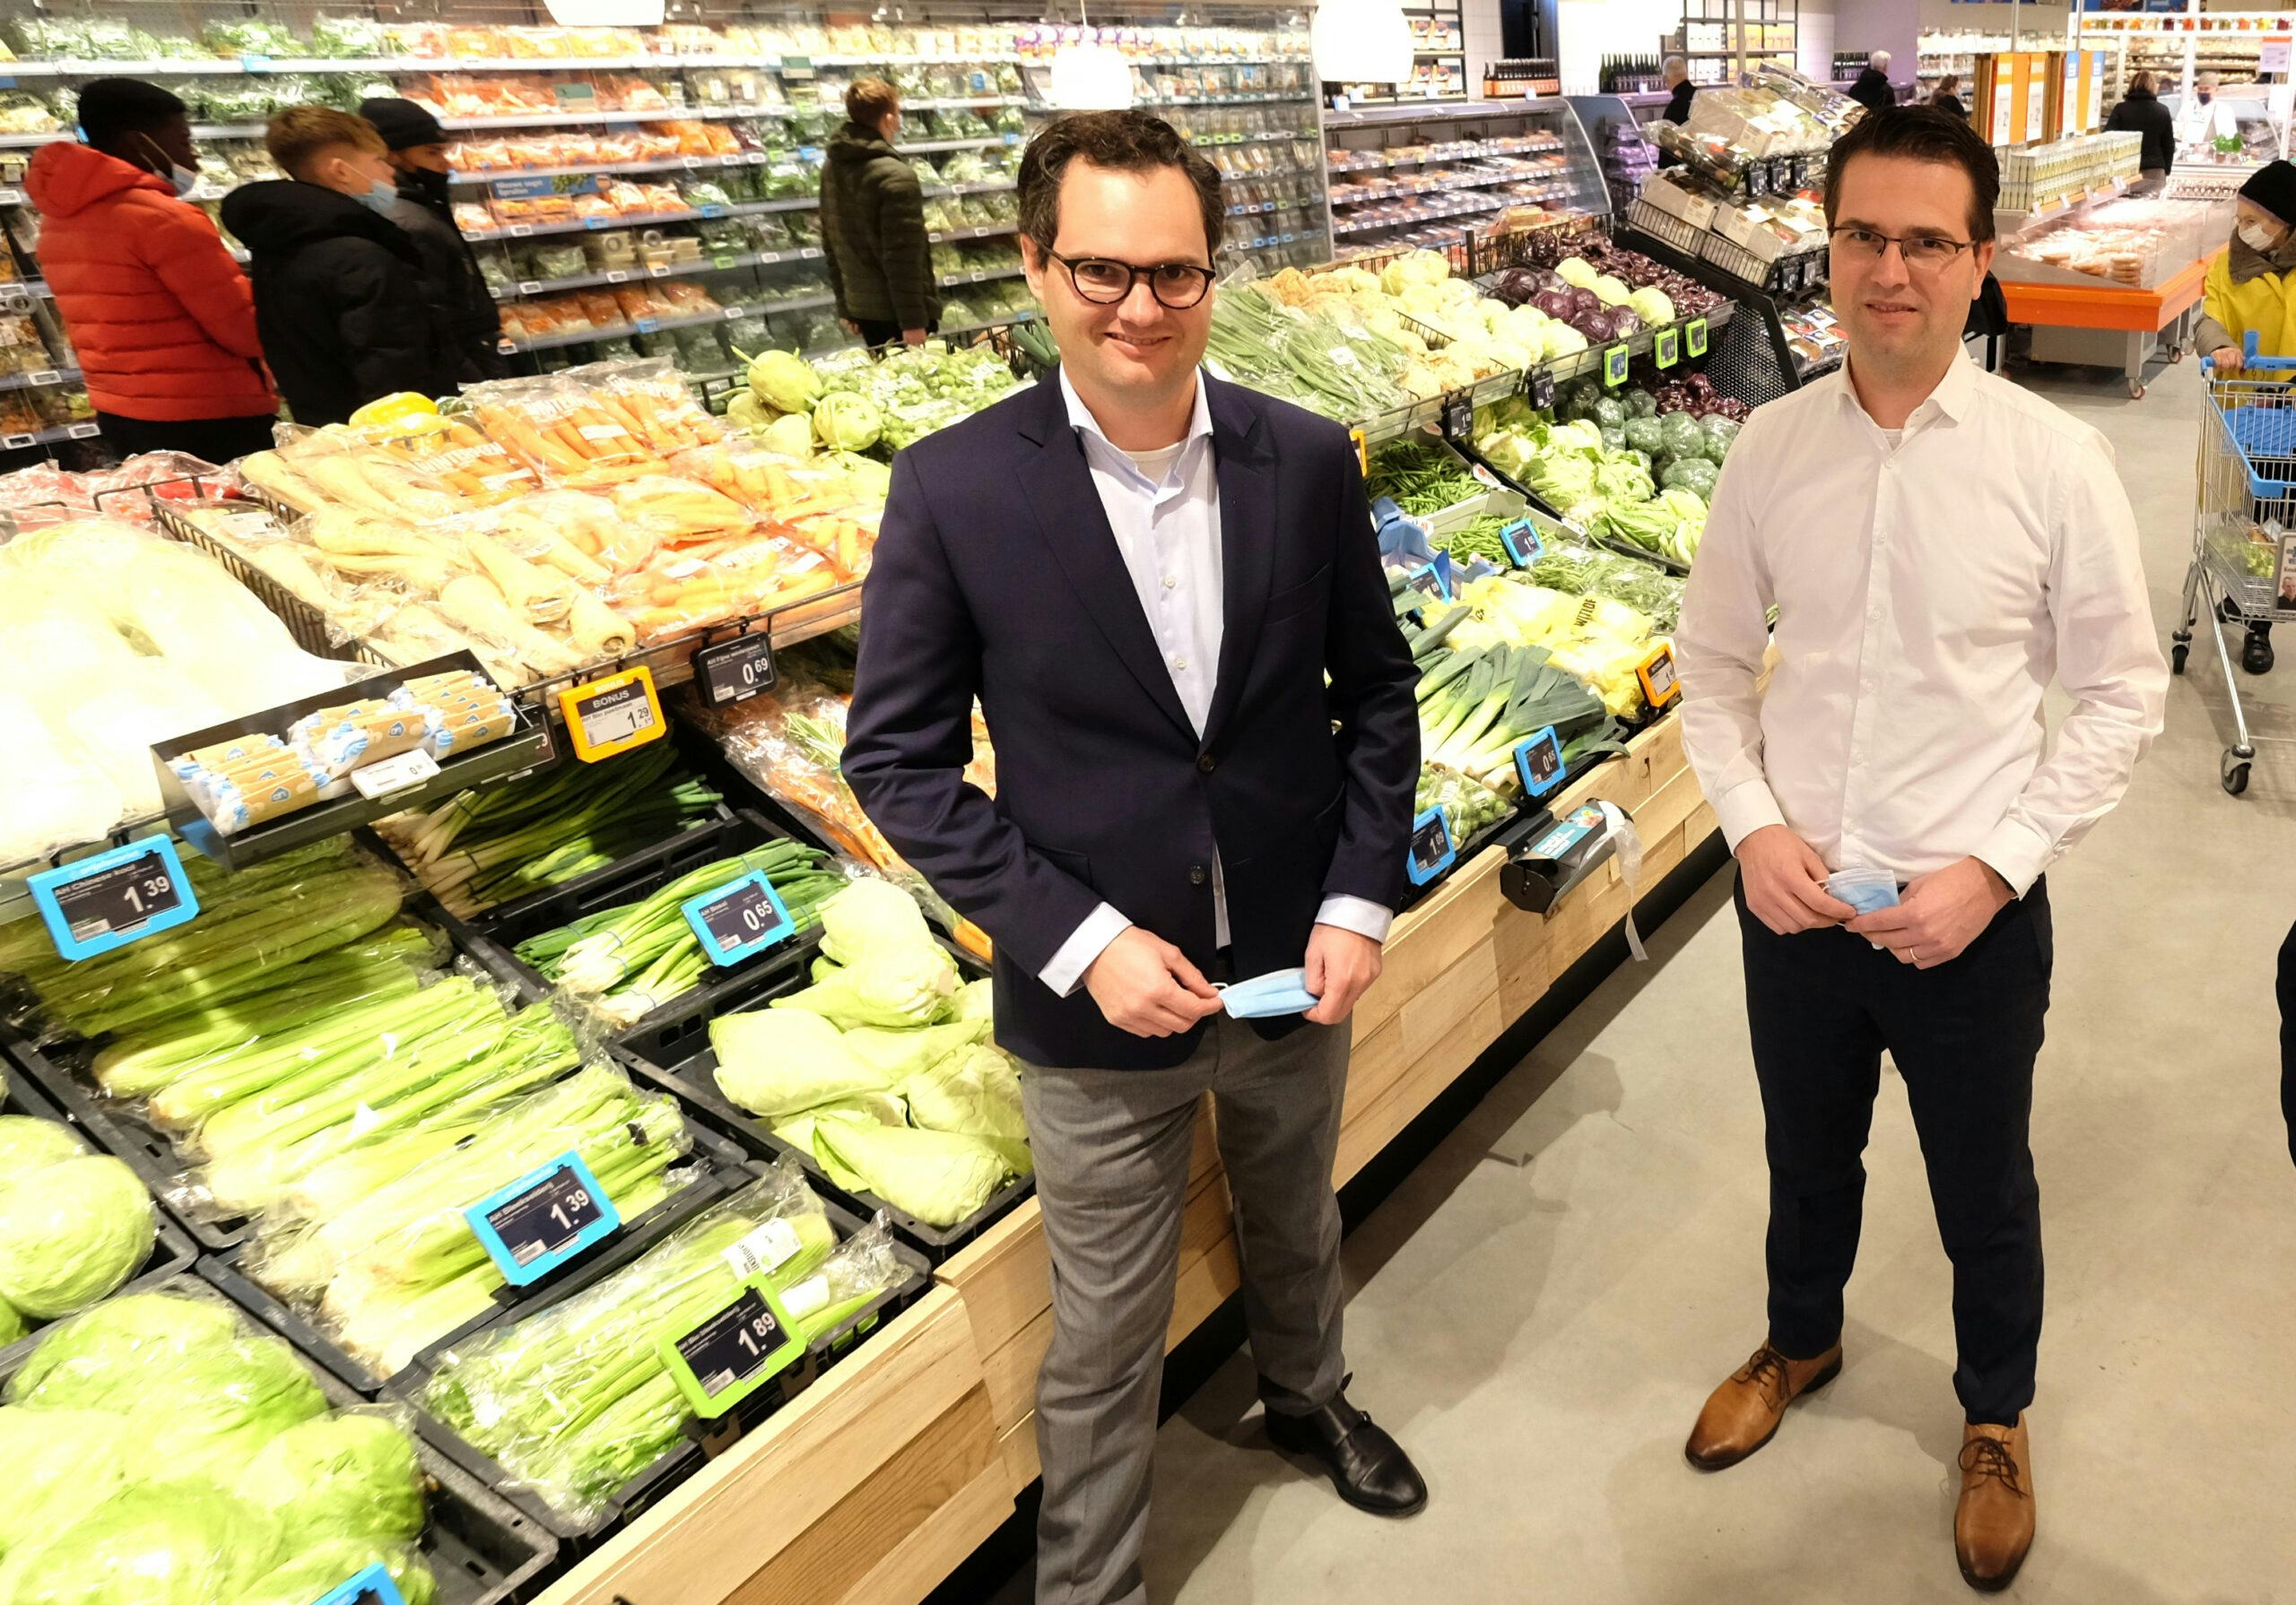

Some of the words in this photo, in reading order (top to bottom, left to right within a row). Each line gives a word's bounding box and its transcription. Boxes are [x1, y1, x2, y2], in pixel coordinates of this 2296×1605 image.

[743, 657, 769, 684] 0.69
[593, 690, 630, 708] BONUS
[627, 707, 649, 729] 1.29
[124, 876, 170, 913] 1.39
[743, 900, 772, 931] 0.65
[550, 1189, 589, 1230] 1.39
[738, 1312, 777, 1358] 1.89
